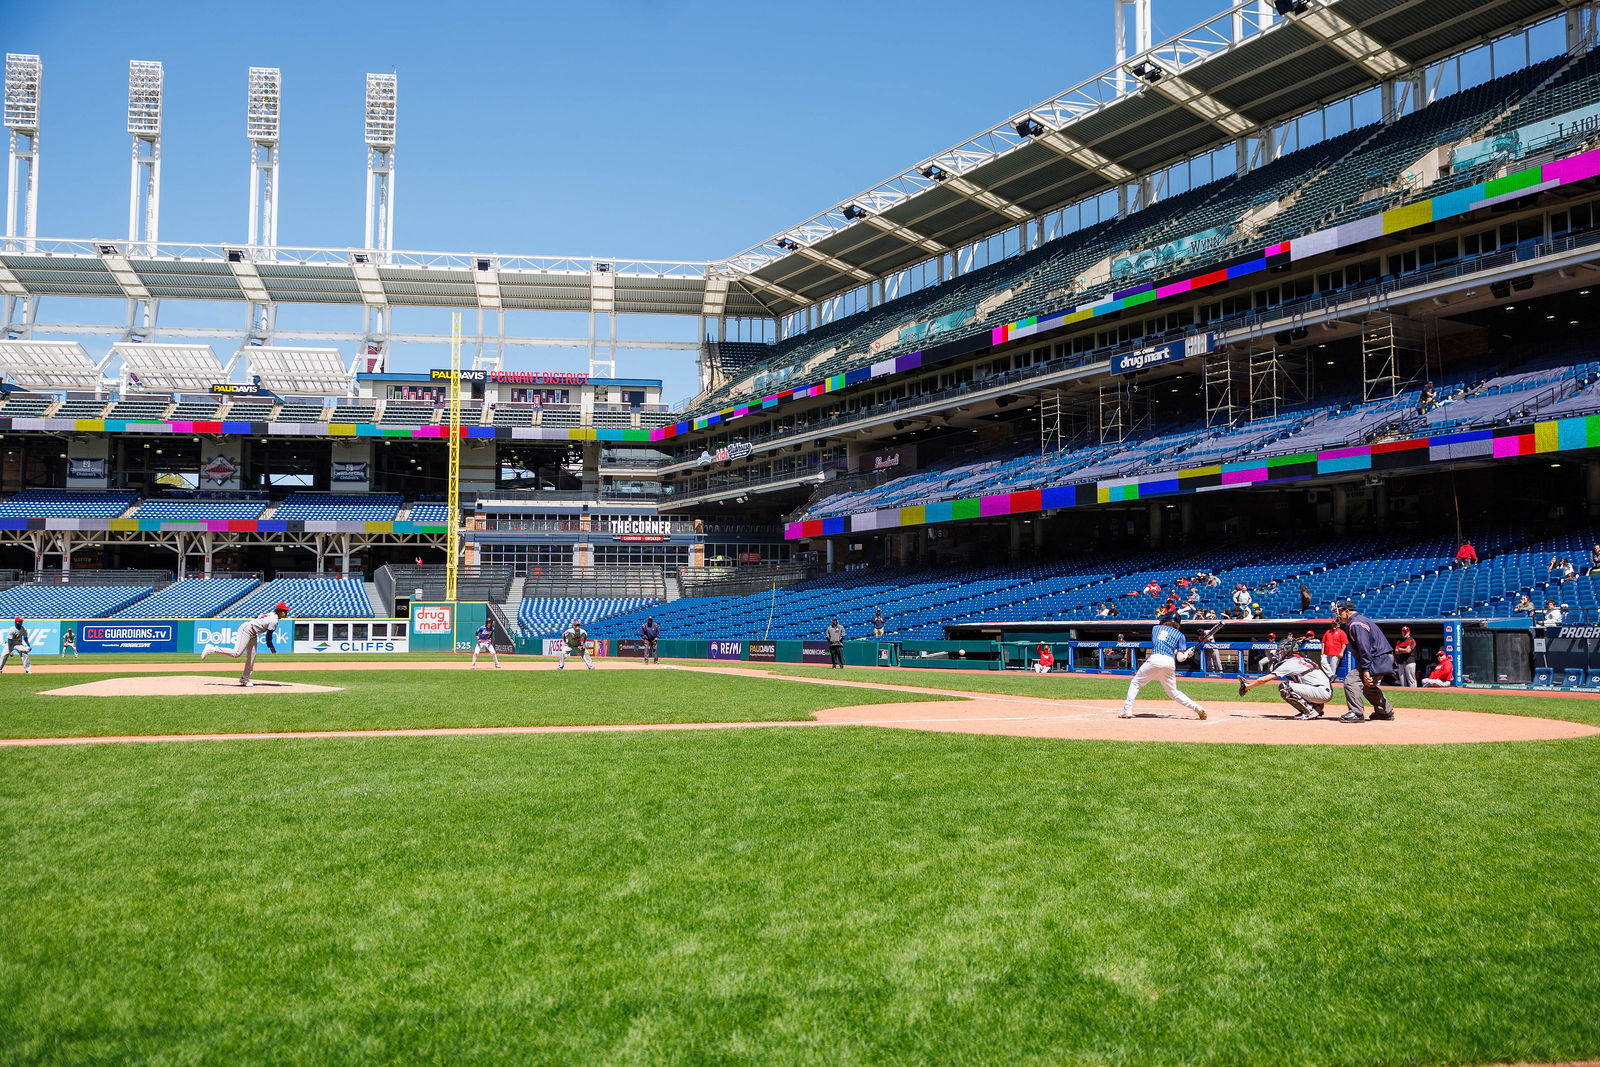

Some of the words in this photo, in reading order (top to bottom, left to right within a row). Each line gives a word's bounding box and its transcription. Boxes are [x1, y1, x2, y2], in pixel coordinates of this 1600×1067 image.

[1120, 354, 1144, 369] drug
[1145, 347, 1170, 363] mart
[432, 371, 485, 380] PAUAVIS
[490, 370, 540, 384] PENNANT
[542, 371, 589, 385] DISTRICT
[611, 520, 630, 534] THE
[632, 520, 671, 534] CORNER
[416, 604, 445, 623] drug
[419, 619, 451, 630] mart
[197, 628, 239, 645] Dolla
[256, 628, 286, 645] ank
[339, 642, 395, 652] CLIFFS
[456, 641, 471, 650] 325
